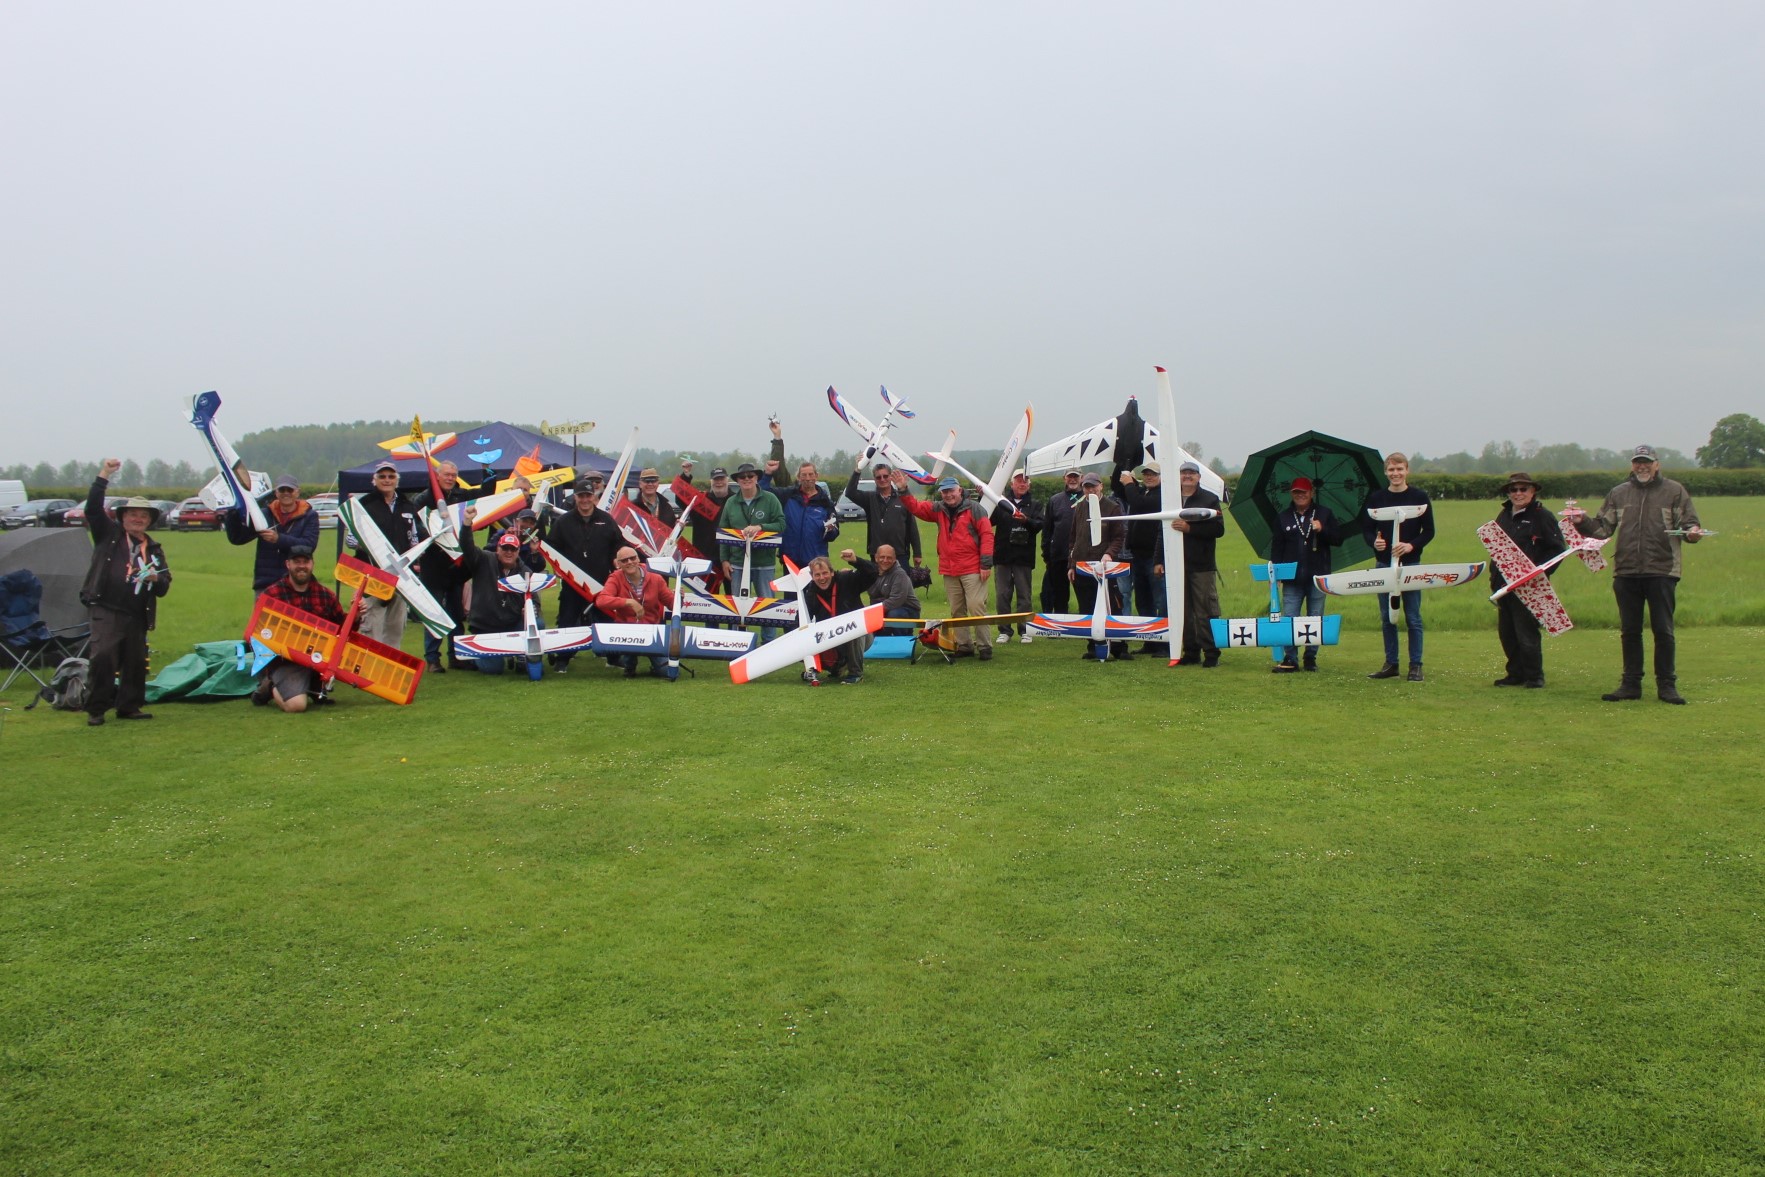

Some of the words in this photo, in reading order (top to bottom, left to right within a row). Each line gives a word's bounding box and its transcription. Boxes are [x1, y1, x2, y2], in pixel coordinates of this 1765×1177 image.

[1347, 580, 1385, 589] MULTIPLEX
[828, 621, 858, 639] WOT
[609, 636, 645, 644] RUCKUS
[814, 631, 825, 644] 4
[698, 640, 748, 648] MAX-THRUST
